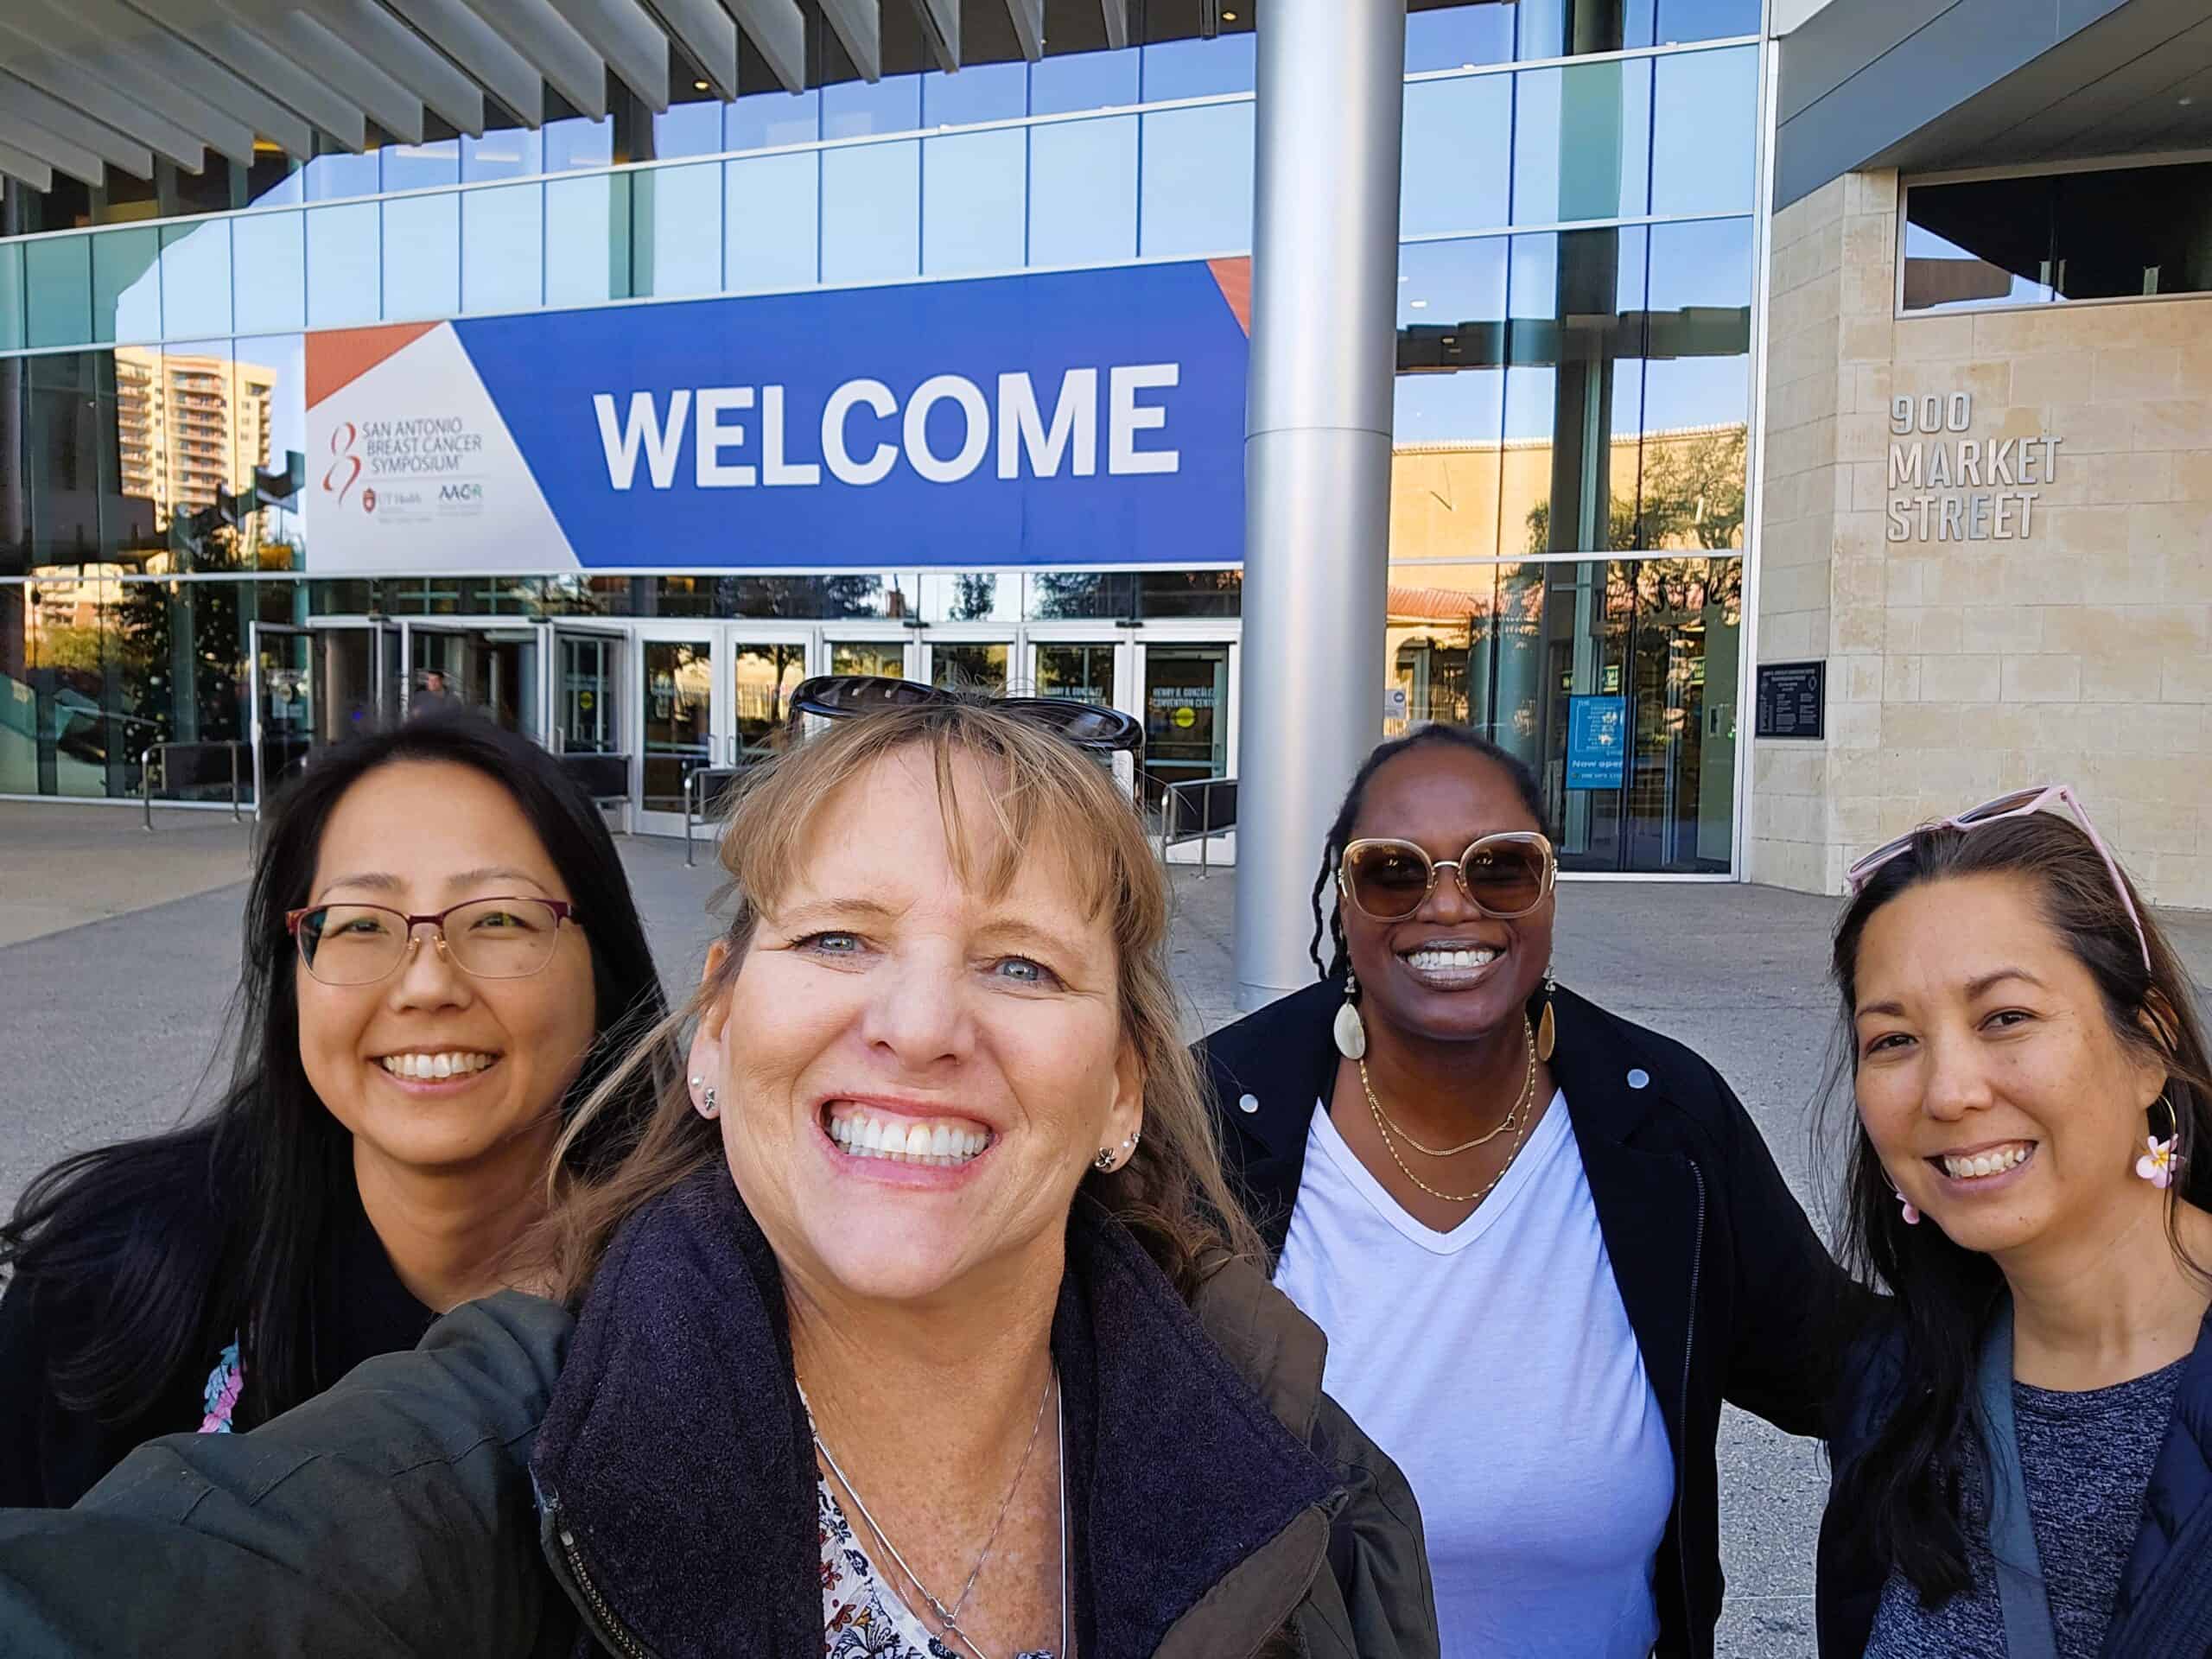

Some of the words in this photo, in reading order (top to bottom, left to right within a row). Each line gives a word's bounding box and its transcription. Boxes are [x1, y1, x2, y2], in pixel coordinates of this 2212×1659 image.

[362, 421, 391, 440] SAN
[395, 416, 462, 436] ANTONIO
[593, 363, 1179, 490] WELCOME
[1891, 392, 1971, 435] 900
[366, 438, 417, 456] BREAST
[422, 434, 482, 454] CANCER
[372, 454, 460, 474] SYMPOSIUM
[1887, 435, 2064, 490] MARKET
[1887, 492, 2040, 542] STREET
